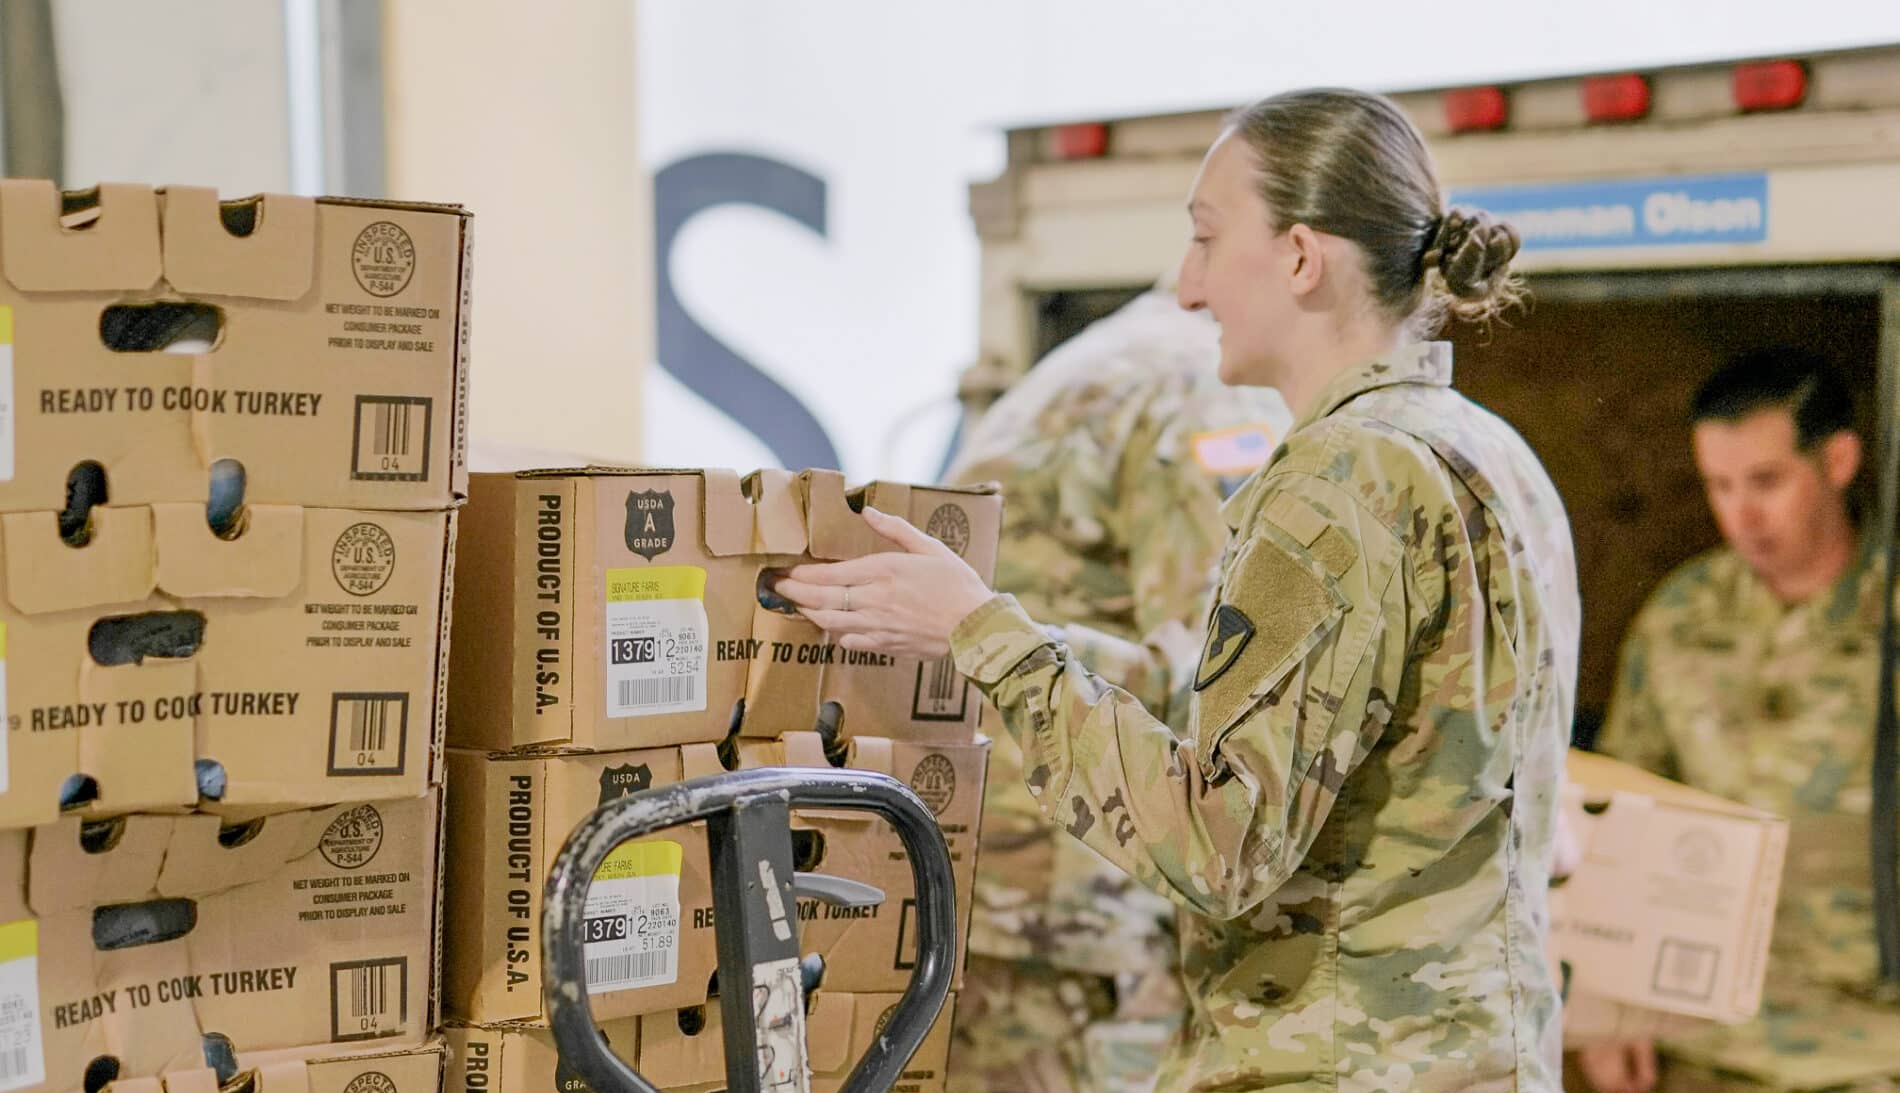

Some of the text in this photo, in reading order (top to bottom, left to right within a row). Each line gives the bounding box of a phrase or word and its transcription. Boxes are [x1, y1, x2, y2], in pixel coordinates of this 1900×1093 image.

[1644, 192, 1761, 236] Olson
[354, 224, 412, 258] INSPECTED
[374, 246, 396, 264] U.S.
[370, 280, 394, 291] P-544
[40, 386, 322, 417] READY TO COOK TURKEY
[381, 456, 400, 471] 04
[637, 499, 664, 510] USDA
[644, 512, 656, 532] A
[336, 526, 393, 556] INSPECTED
[634, 538, 668, 548] GRADE
[354, 546, 376, 564] U.S.
[350, 580, 374, 591] P-544
[612, 580, 660, 594] SIGNATURE FARMS
[535, 494, 562, 715] PRODUCT OF U.S.A.
[612, 638, 676, 662] 1379 12
[771, 642, 792, 663] TO
[798, 643, 836, 665] COOK
[32, 703, 107, 732] READY
[118, 700, 145, 723] TO
[210, 692, 300, 716] TURKEY
[358, 752, 376, 766] 04
[612, 773, 640, 784] USDA
[340, 822, 364, 839] U.S.
[337, 852, 362, 864] P-544
[614, 860, 632, 871] FARMS
[293, 872, 410, 890] NET WEIGHT TO BE MARKED ON
[506, 775, 532, 992] PRODUCT OF U.S.A.
[313, 889, 394, 904] CONSUMER PACKAGE
[298, 903, 406, 921] PRIOR TO DISPLAY AND SALE
[584, 914, 648, 941] 1379 12
[54, 990, 117, 1030] READY
[126, 984, 151, 1009] TO
[158, 975, 203, 1004] COOK
[210, 966, 298, 996] TURKEY
[360, 1018, 378, 1030] 04
